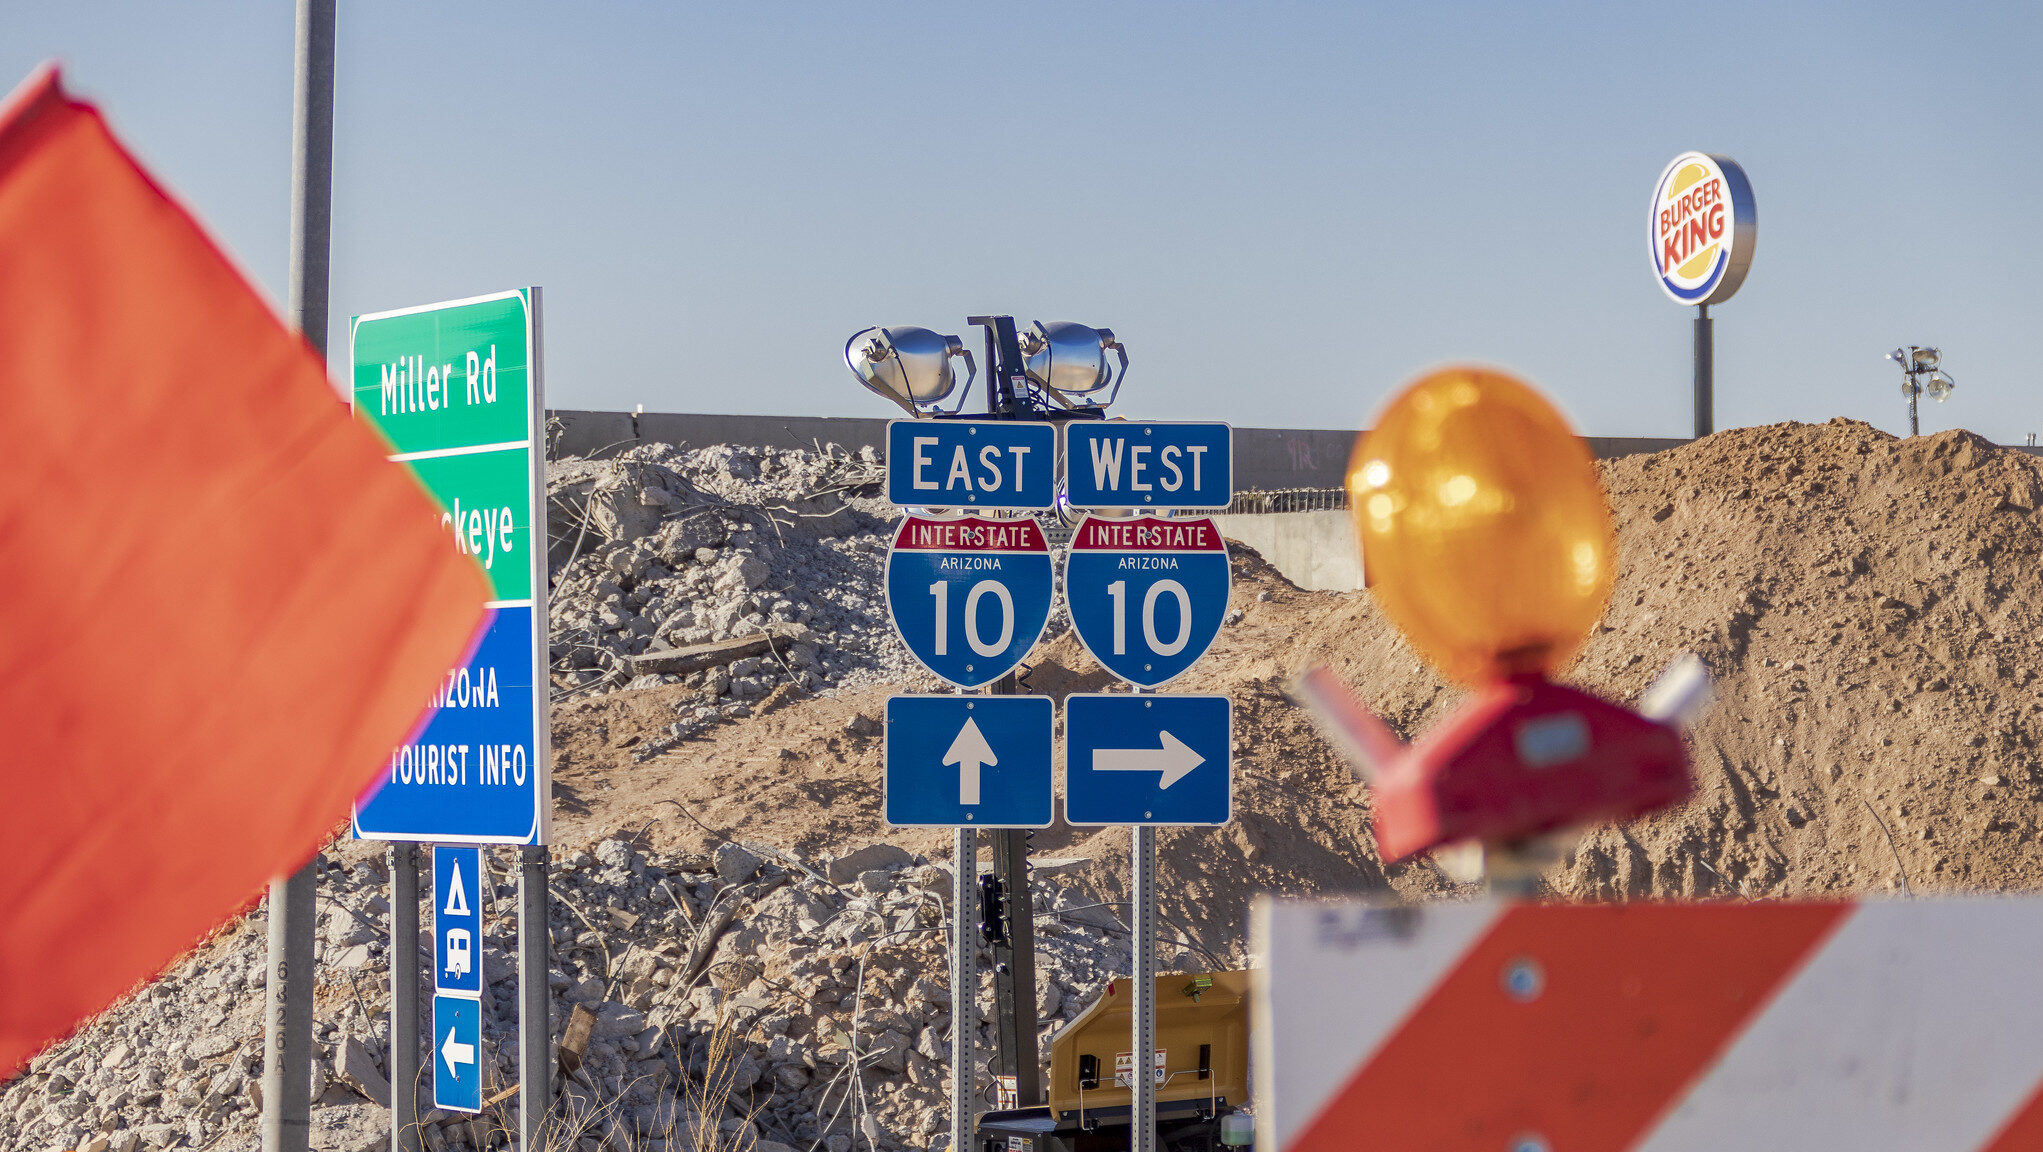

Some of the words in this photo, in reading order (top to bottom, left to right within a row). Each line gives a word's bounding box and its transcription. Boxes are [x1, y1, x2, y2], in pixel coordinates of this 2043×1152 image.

[1660, 178, 1721, 238] BURGER
[1664, 203, 1725, 275] KING
[381, 354, 452, 416] Miller
[466, 344, 497, 405] Rd
[913, 436, 1031, 492] EAST
[1089, 438, 1208, 492] WEST
[911, 525, 1031, 547] INTERSTATE
[940, 557, 1002, 570] ARIZONA
[1089, 525, 1208, 547] INTERSTATE
[1118, 557, 1179, 570] ARIZONA
[929, 579, 1015, 658] 10
[1107, 578, 1192, 657] 10
[391, 744, 469, 786] TOURIST
[479, 744, 526, 786] INFO
[274, 960, 288, 1072] 6326A
